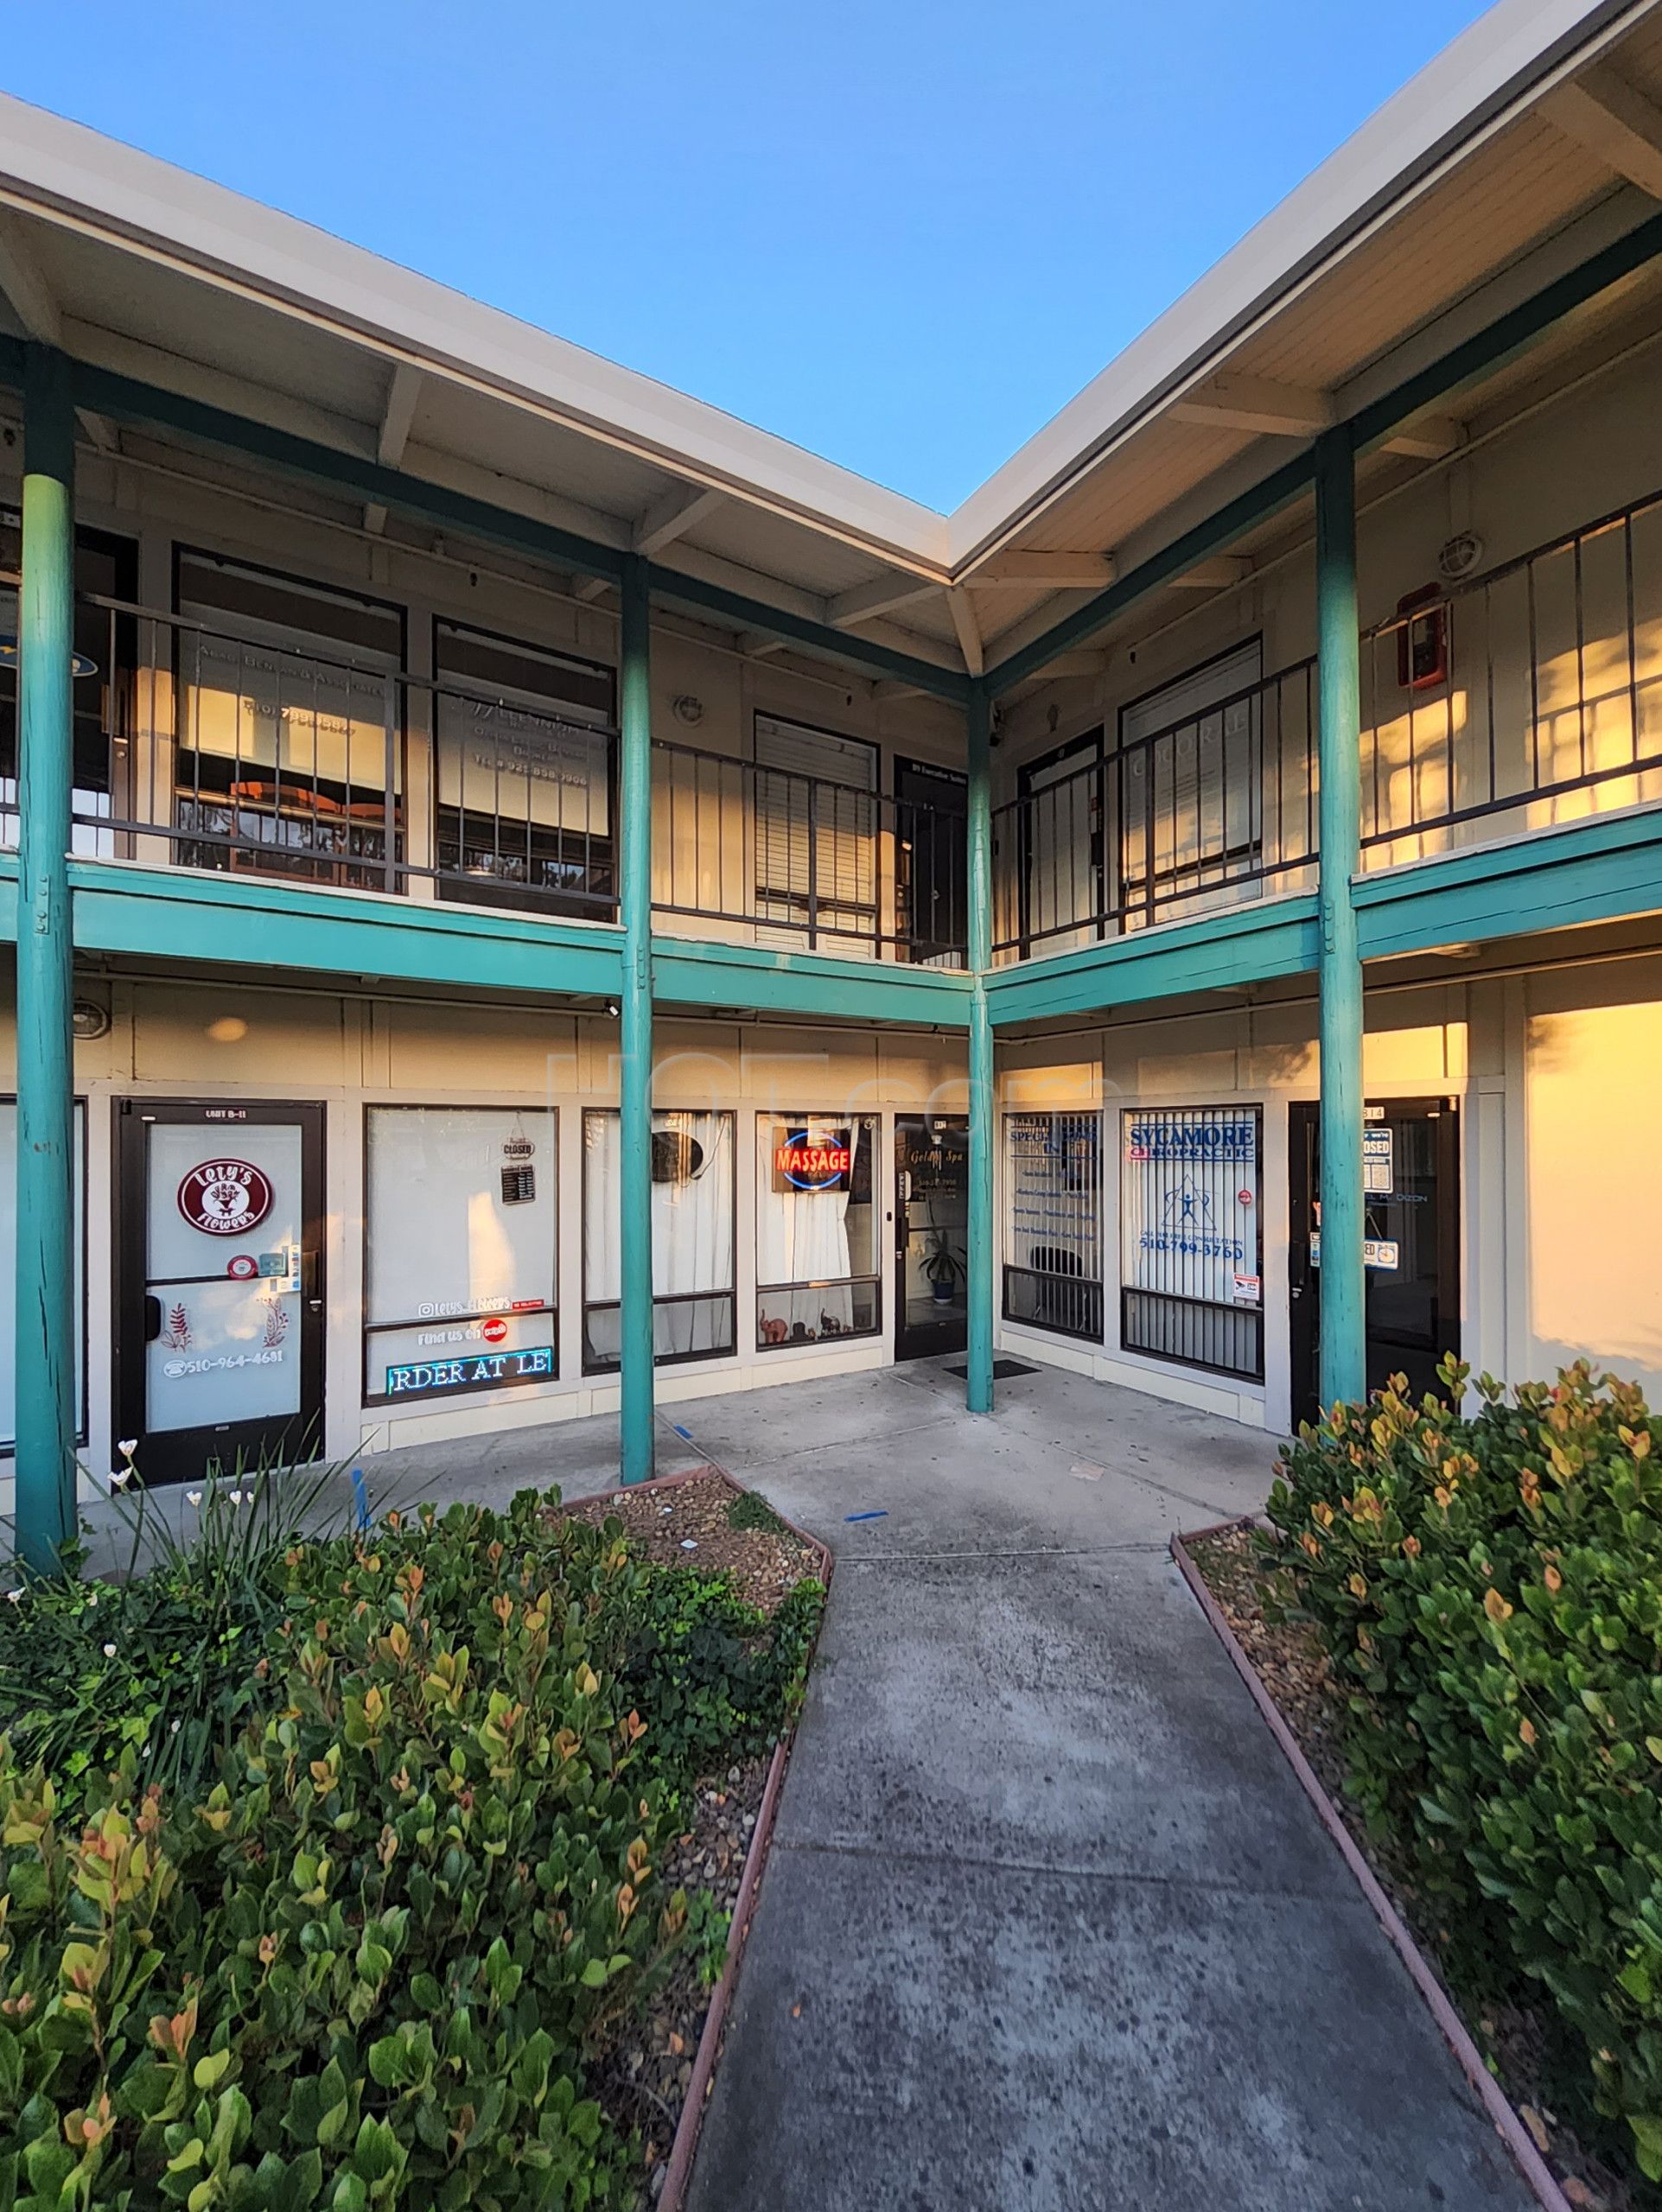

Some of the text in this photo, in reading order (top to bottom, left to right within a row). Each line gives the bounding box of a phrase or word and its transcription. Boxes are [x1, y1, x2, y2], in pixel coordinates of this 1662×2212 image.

[1130, 1126, 1254, 1146] SYCAMORE
[504, 1144, 532, 1154] CLOSED
[1130, 1147, 1254, 1158] CHIROPRACTIC
[1363, 1141, 1390, 1154] OSED
[777, 1147, 849, 1172] MASSAGE
[1139, 1236, 1244, 1260] 510-799-3760
[448, 1331, 462, 1342] us
[465, 1329, 481, 1340] on
[393, 1351, 549, 1391] RDER AT LE
